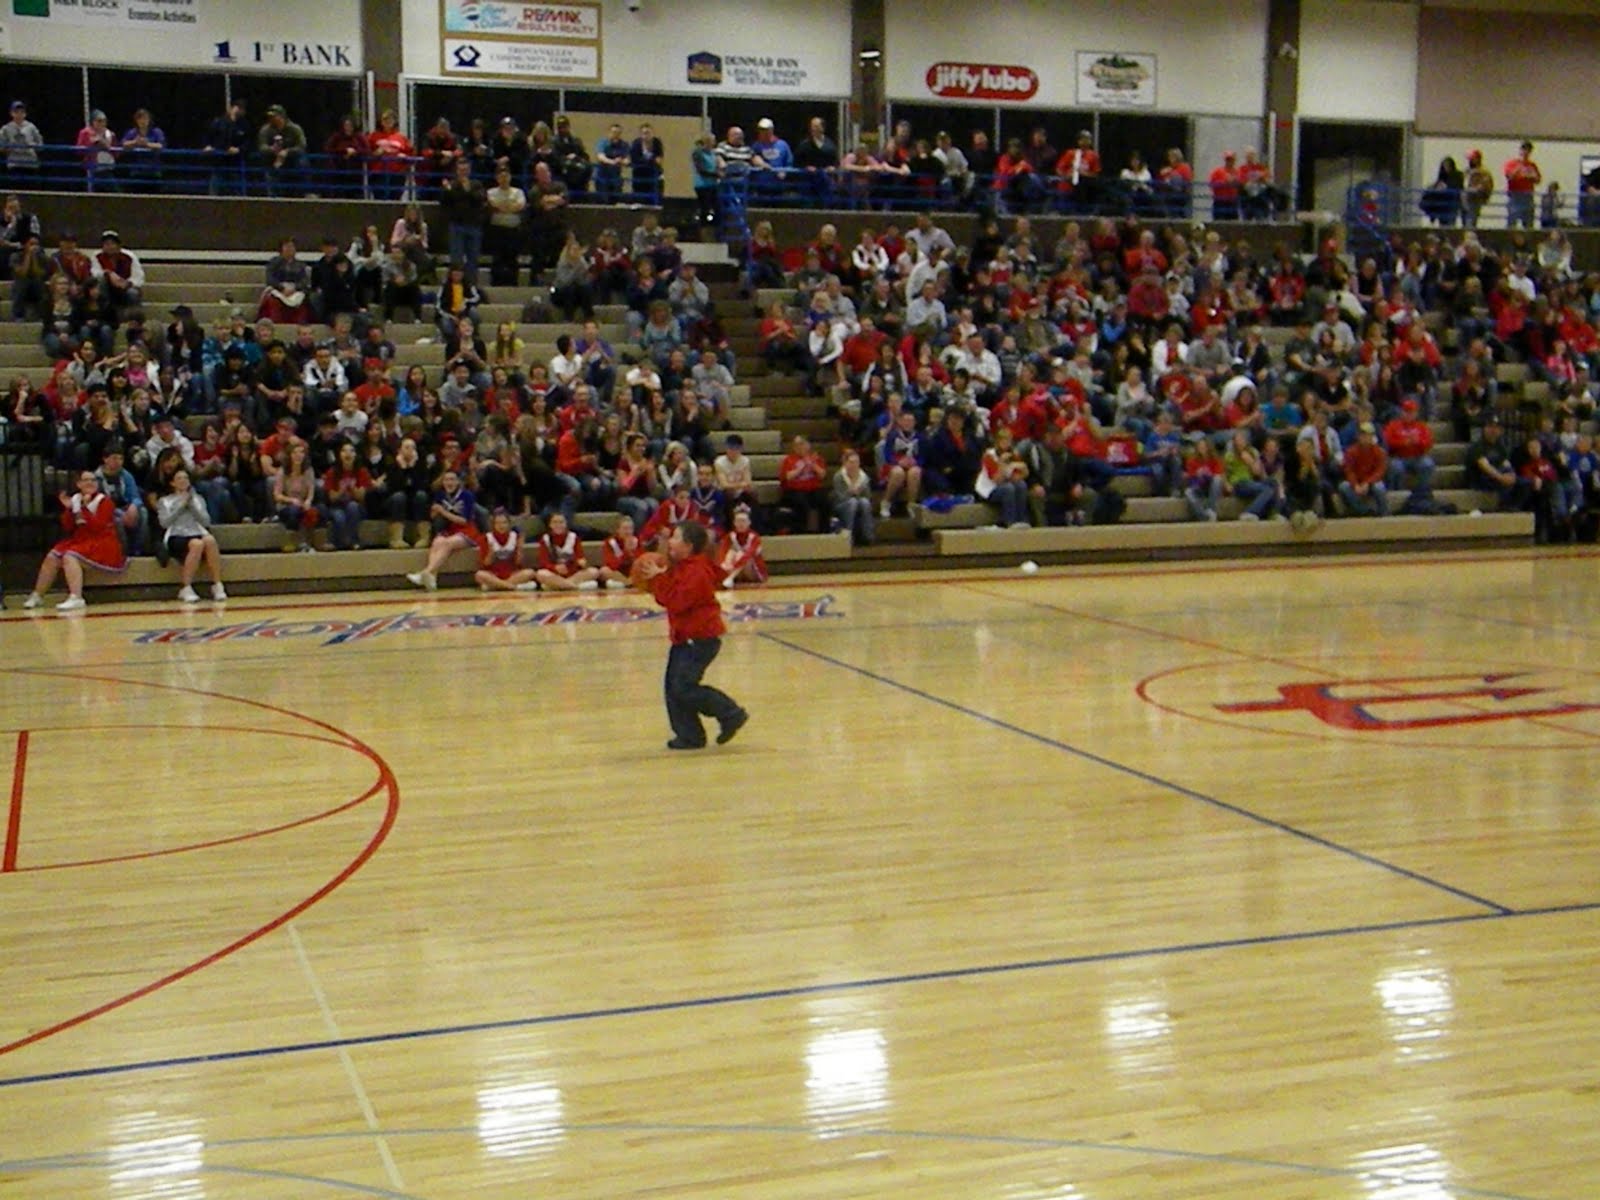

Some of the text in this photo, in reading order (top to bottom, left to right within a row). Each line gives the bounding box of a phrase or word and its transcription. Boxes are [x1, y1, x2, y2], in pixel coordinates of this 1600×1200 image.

[282, 42, 351, 66] BANK
[932, 65, 1032, 94] jiffy lube
